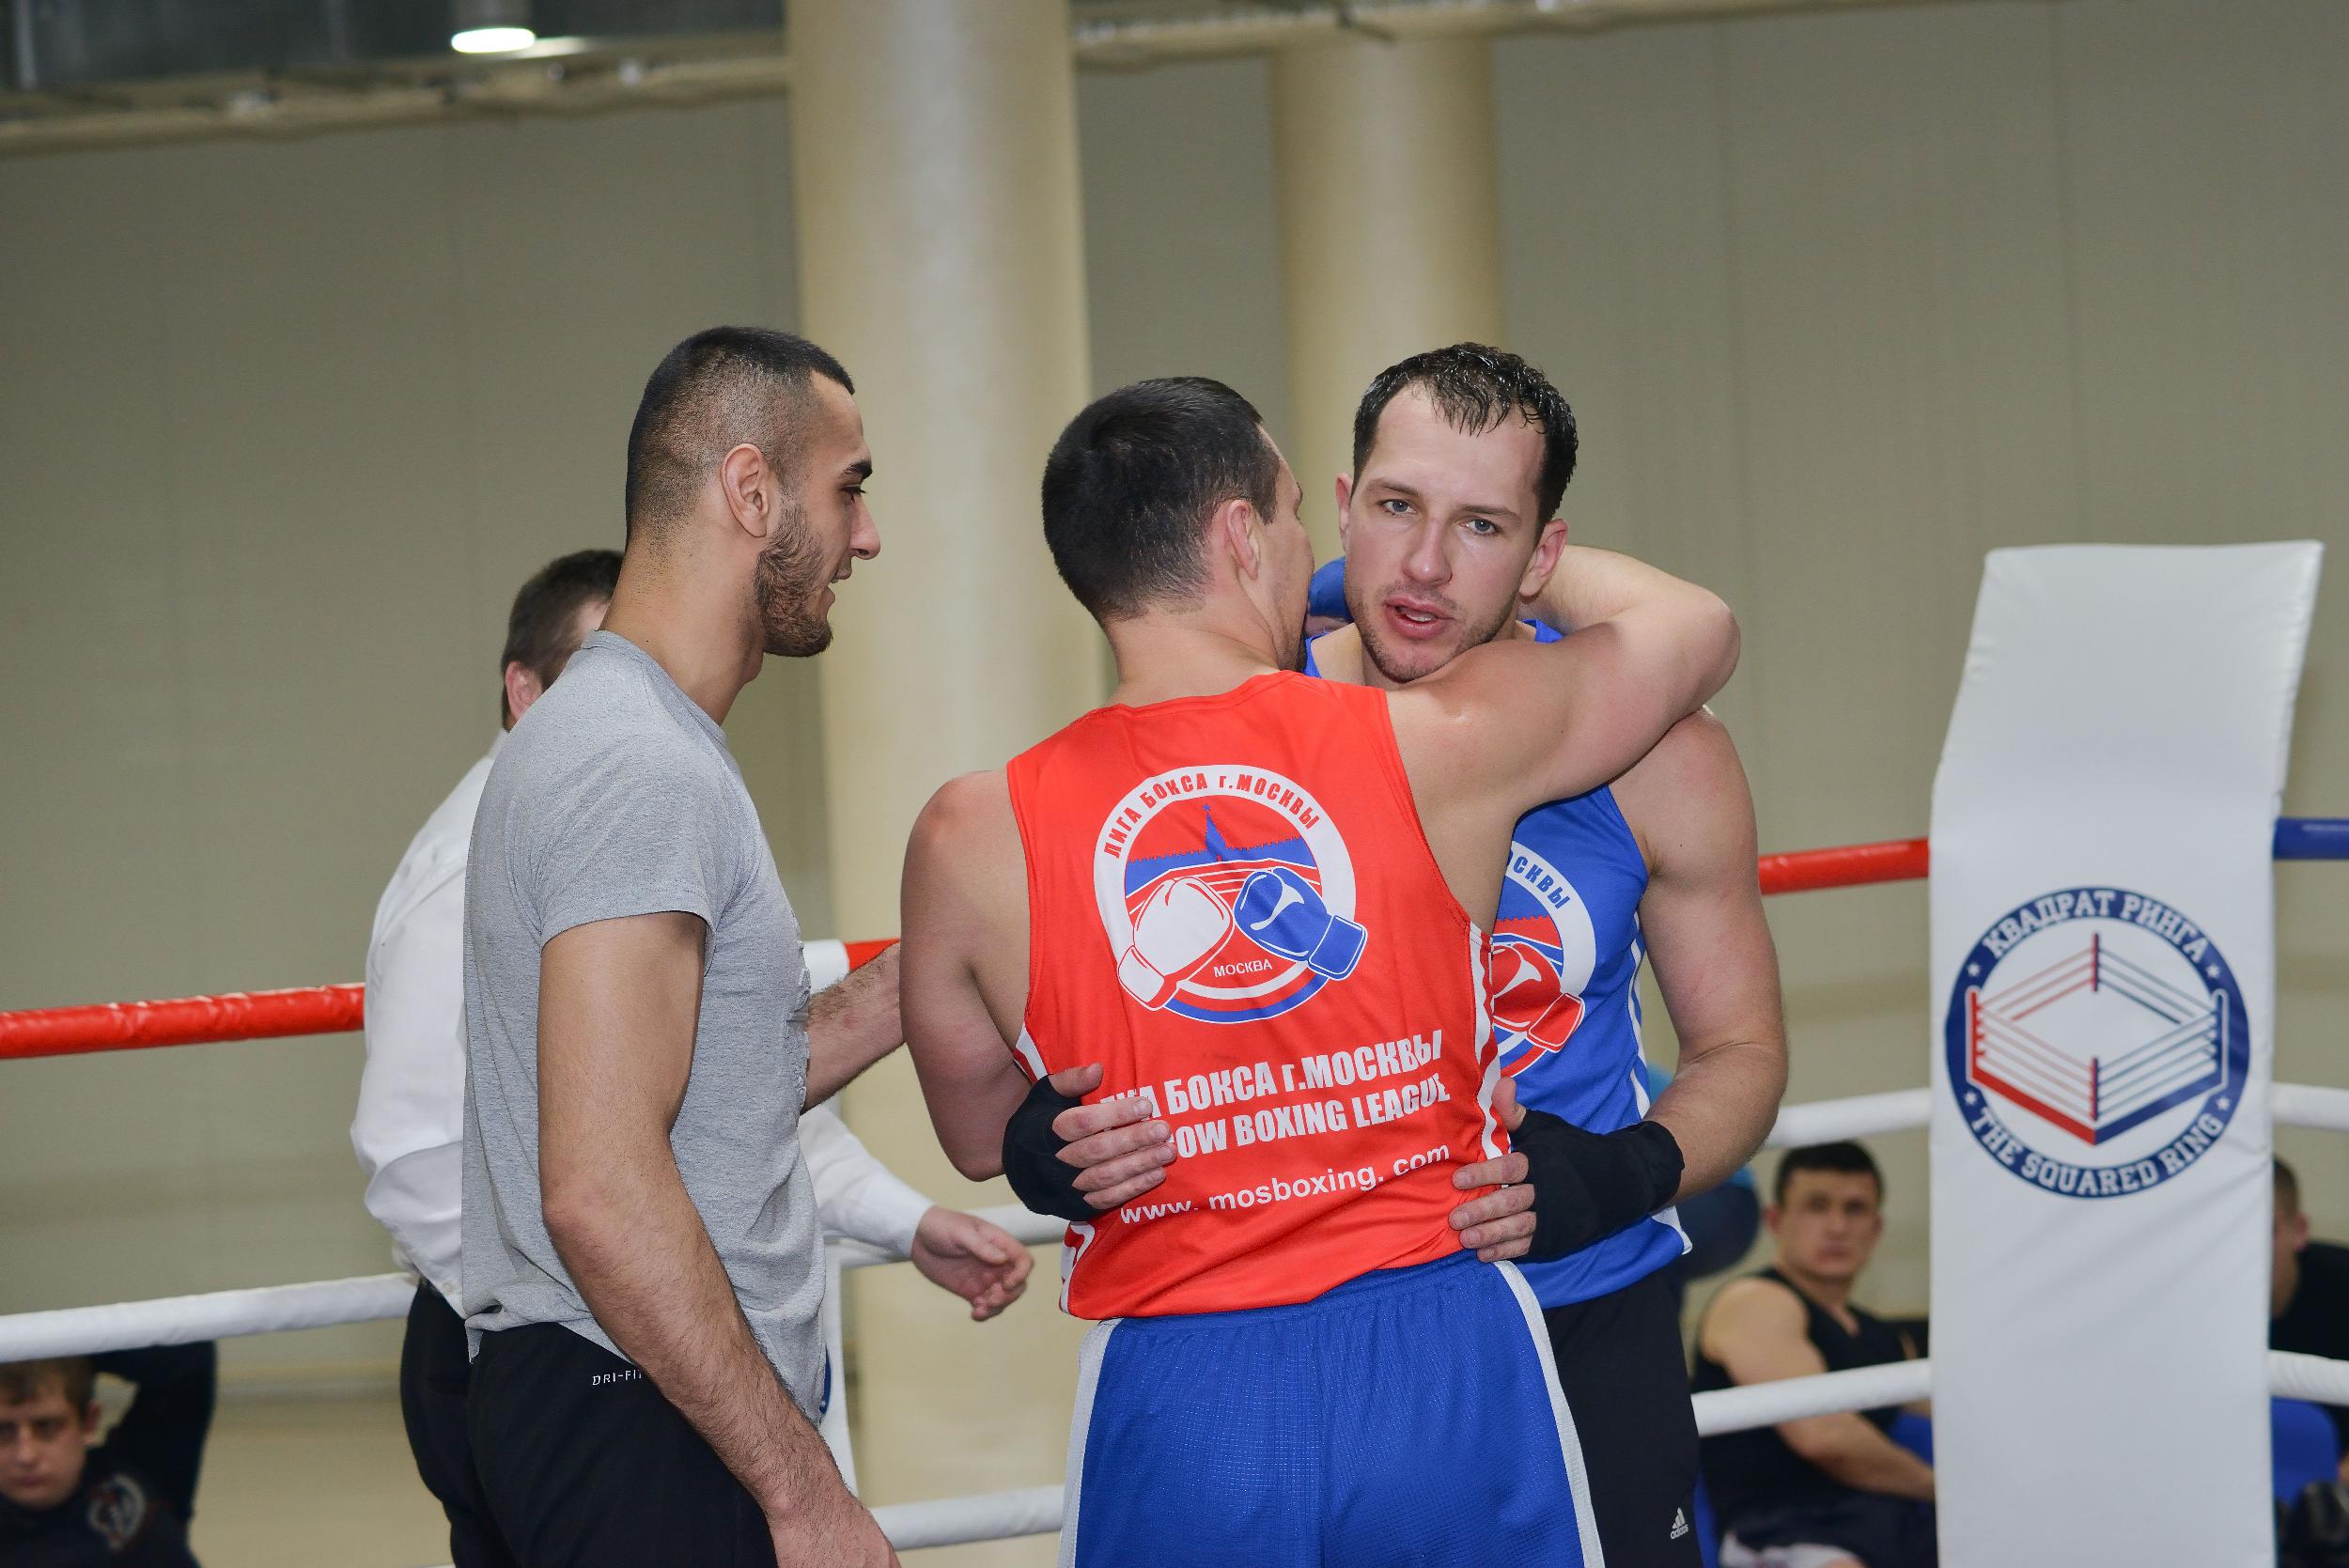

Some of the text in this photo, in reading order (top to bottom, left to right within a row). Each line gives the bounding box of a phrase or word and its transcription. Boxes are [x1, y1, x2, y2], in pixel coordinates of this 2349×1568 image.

[1103, 807, 1143, 859] ЛИГА
[1139, 772, 1208, 809] БОКСА
[1508, 849, 1571, 909] СКВЫ
[1982, 889, 2211, 964] КВАДРАТ РИНГА
[1213, 958, 1273, 978] МОСКВА
[1164, 1062, 1278, 1115] БОКСА
[1235, 1099, 1348, 1149] BOXING
[1351, 1072, 1452, 1128] LEAGUE
[1392, 1144, 1450, 1176] com
[1972, 1107, 2225, 1196] THE SQUARED RING
